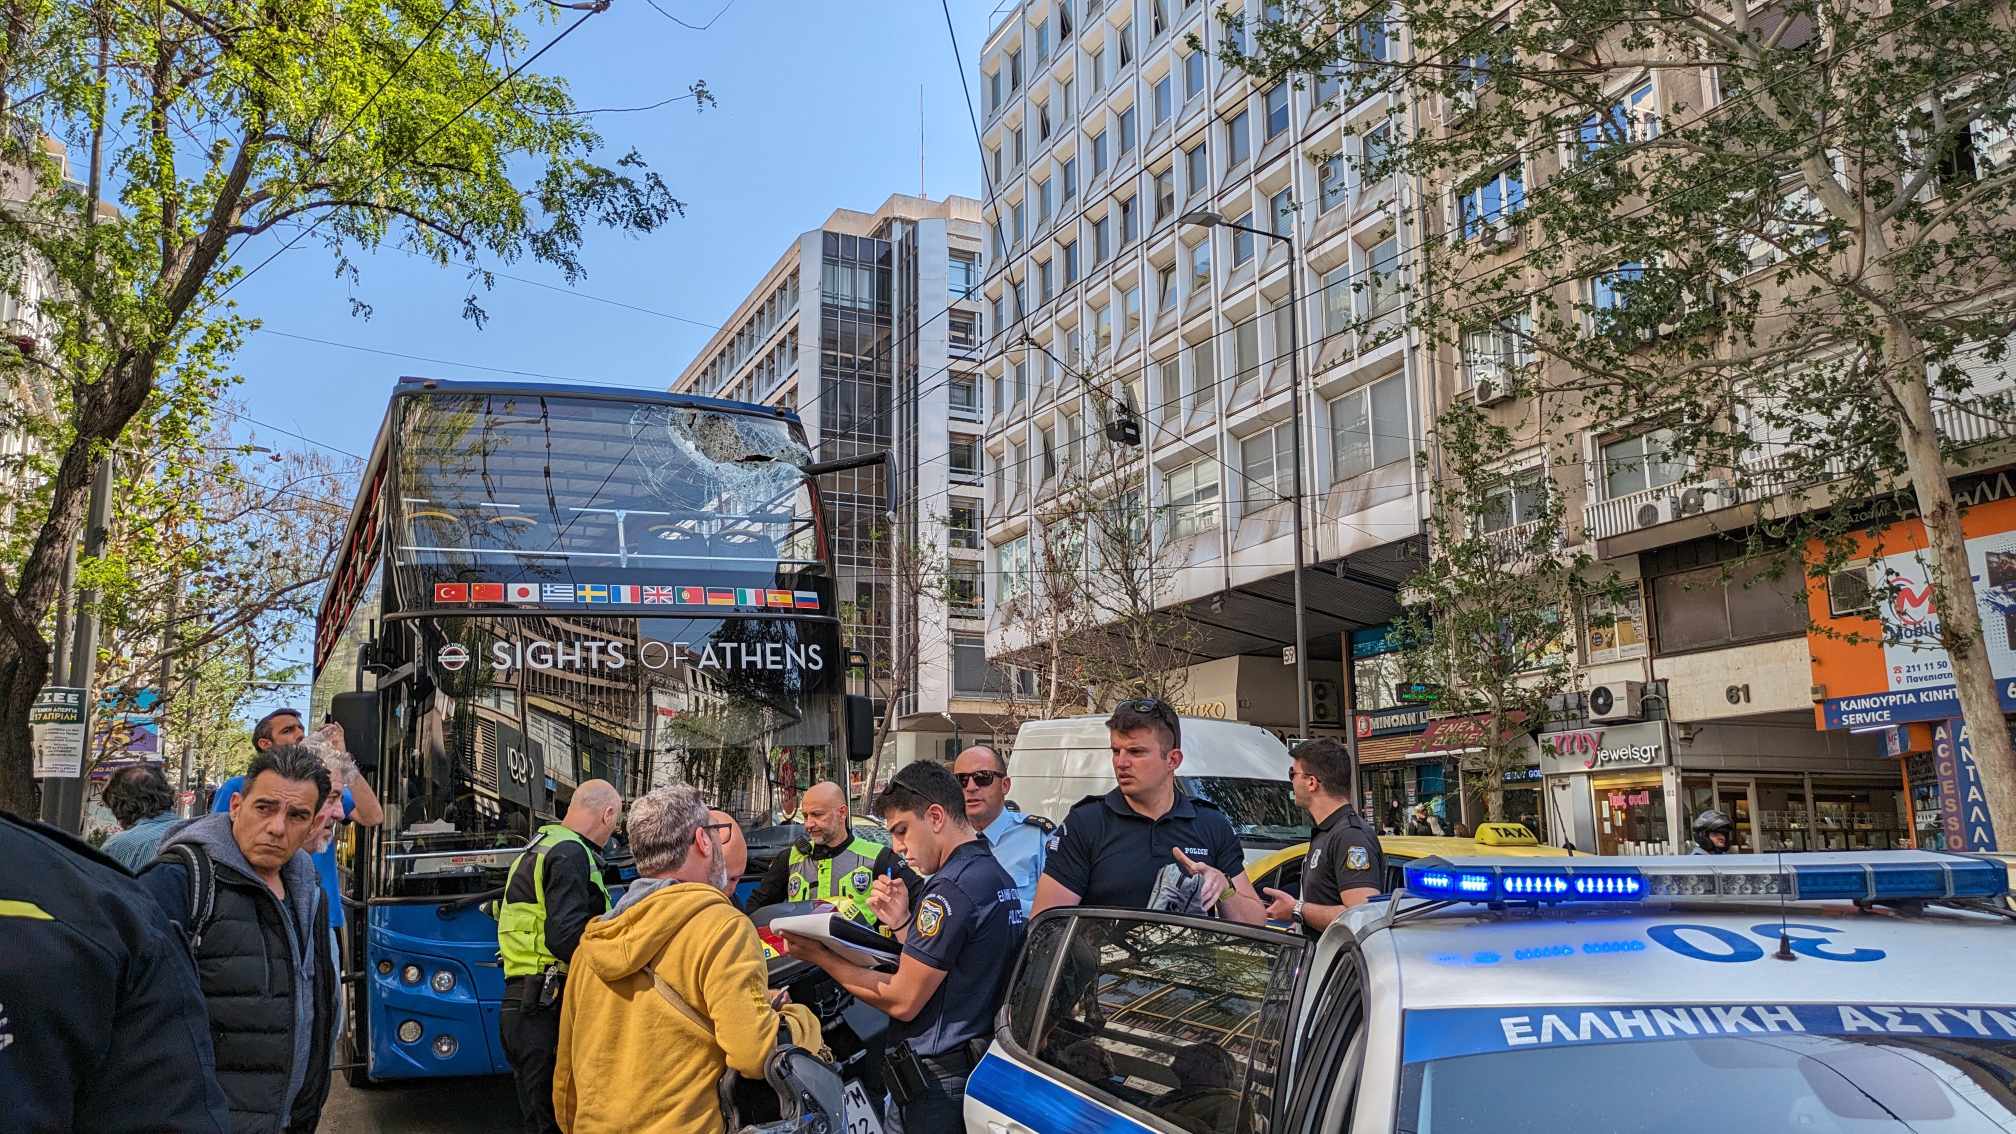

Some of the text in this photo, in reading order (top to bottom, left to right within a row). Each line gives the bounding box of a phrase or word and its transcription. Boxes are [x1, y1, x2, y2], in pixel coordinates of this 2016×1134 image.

[491, 641, 823, 671] SIGHTS OF ATHENS
[1905, 661, 1948, 673] 211 11 50
[1906, 672, 1953, 684] Πανεπιστη
[36, 692, 80, 704] ΣΕΕ
[1726, 684, 1751, 704] 61
[1840, 688, 1958, 712] ΚΑΙΝΟΥΡΓΙΑ ΚΙΝΗΤ
[1842, 710, 1891, 726] SERVICE
[1553, 731, 1603, 768] my
[1528, 769, 1543, 778] GOL
[1935, 725, 1964, 849] ACCESSO
[1490, 827, 1533, 838] TAXI
[1184, 847, 1208, 855] POLICE
[1500, 1005, 1806, 1046] ΕΛΛΗΝΙΚΗ
